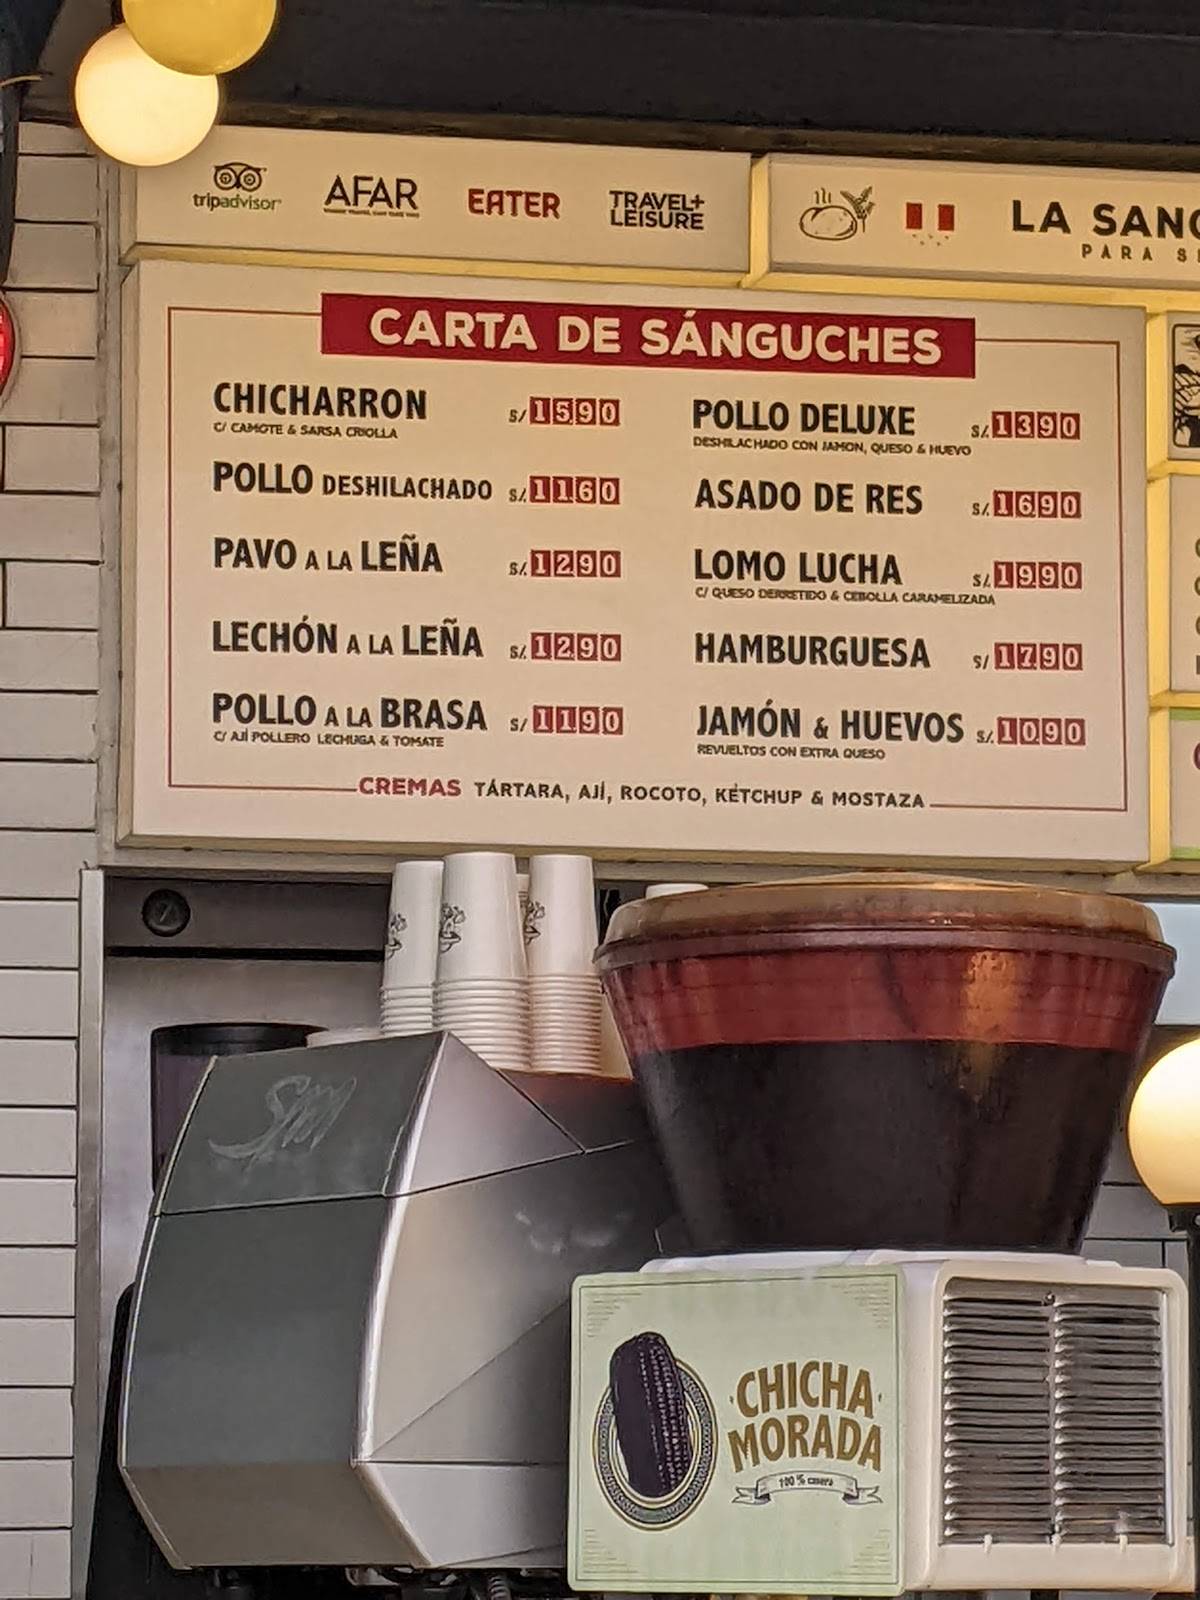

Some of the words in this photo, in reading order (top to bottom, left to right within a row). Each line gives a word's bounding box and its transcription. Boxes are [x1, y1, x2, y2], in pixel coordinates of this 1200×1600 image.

[193, 192, 278, 211] tripadvisor
[324, 175, 418, 210] AFAR
[467, 188, 561, 219] EATER
[609, 190, 705, 211] TRAVEL+
[610, 209, 704, 230] LEISURE
[1012, 199, 1071, 234] LA
[1081, 243, 1153, 261] PARA
[369, 307, 538, 351] CARTA
[558, 315, 621, 353] DE
[641, 310, 942, 366] SÁNGUCHES
[213, 382, 427, 420] CHICHARRON
[693, 399, 789, 431] POLLO
[800, 403, 916, 436] DELUXE
[230, 422, 283, 435] CAMOTE
[287, 424, 297, 435] &
[300, 425, 342, 437] SARSA
[346, 426, 398, 439] CRIOLLA
[693, 436, 788, 450] DESHILACHADO
[791, 439, 818, 451] CON
[870, 443, 913, 455] QUESO
[916, 443, 926, 454] &
[929, 444, 972, 456] HUEVO
[213, 461, 313, 494] POLLO
[322, 474, 493, 500] DESHILACHADO
[695, 478, 801, 511] ASADO
[815, 482, 854, 513] DE
[866, 484, 923, 515] RES
[214, 537, 298, 570] PAVO
[305, 550, 320, 570] A
[327, 550, 353, 571] LA
[361, 533, 443, 573] LEÑA
[694, 548, 786, 582] LOMO
[799, 551, 903, 585] LUCHA
[712, 587, 755, 600] QUESO
[758, 588, 827, 601] DERRETIDO
[830, 590, 840, 601] &
[843, 590, 898, 603] CEBOLLA
[902, 592, 996, 606] CARAMELIZADA
[213, 616, 338, 654] LECHÓN
[346, 634, 361, 655] A
[368, 634, 394, 655] LA
[401, 617, 484, 657] LEÑA
[695, 632, 931, 668] HAMBURGUESA
[213, 693, 317, 726] POLLO
[324, 706, 339, 727] A
[346, 706, 373, 728] LA
[381, 697, 488, 731] BRASA
[696, 699, 801, 738] JAMÓN
[813, 717, 829, 739] &
[841, 709, 965, 743] HUEVOS
[252, 731, 311, 744] POLLERO
[317, 733, 376, 746] LECHUGA
[379, 734, 389, 747] &
[394, 735, 445, 748] TOMATE
[697, 743, 767, 756] REVUELTOS
[769, 745, 797, 758] CON
[800, 747, 839, 759] EXTRA
[843, 748, 886, 760] QUESO
[359, 776, 462, 797] CREMAS
[474, 779, 570, 803] TÁRTARA,
[578, 781, 613, 804] AJÍ,
[620, 784, 707, 806] ROCOTO,
[715, 783, 802, 805] KÉTCHUP
[810, 791, 824, 806] &
[832, 791, 925, 809] MOSTAZA
[736, 1360, 874, 1419] CHICHA
[727, 1413, 881, 1473] MORADA
